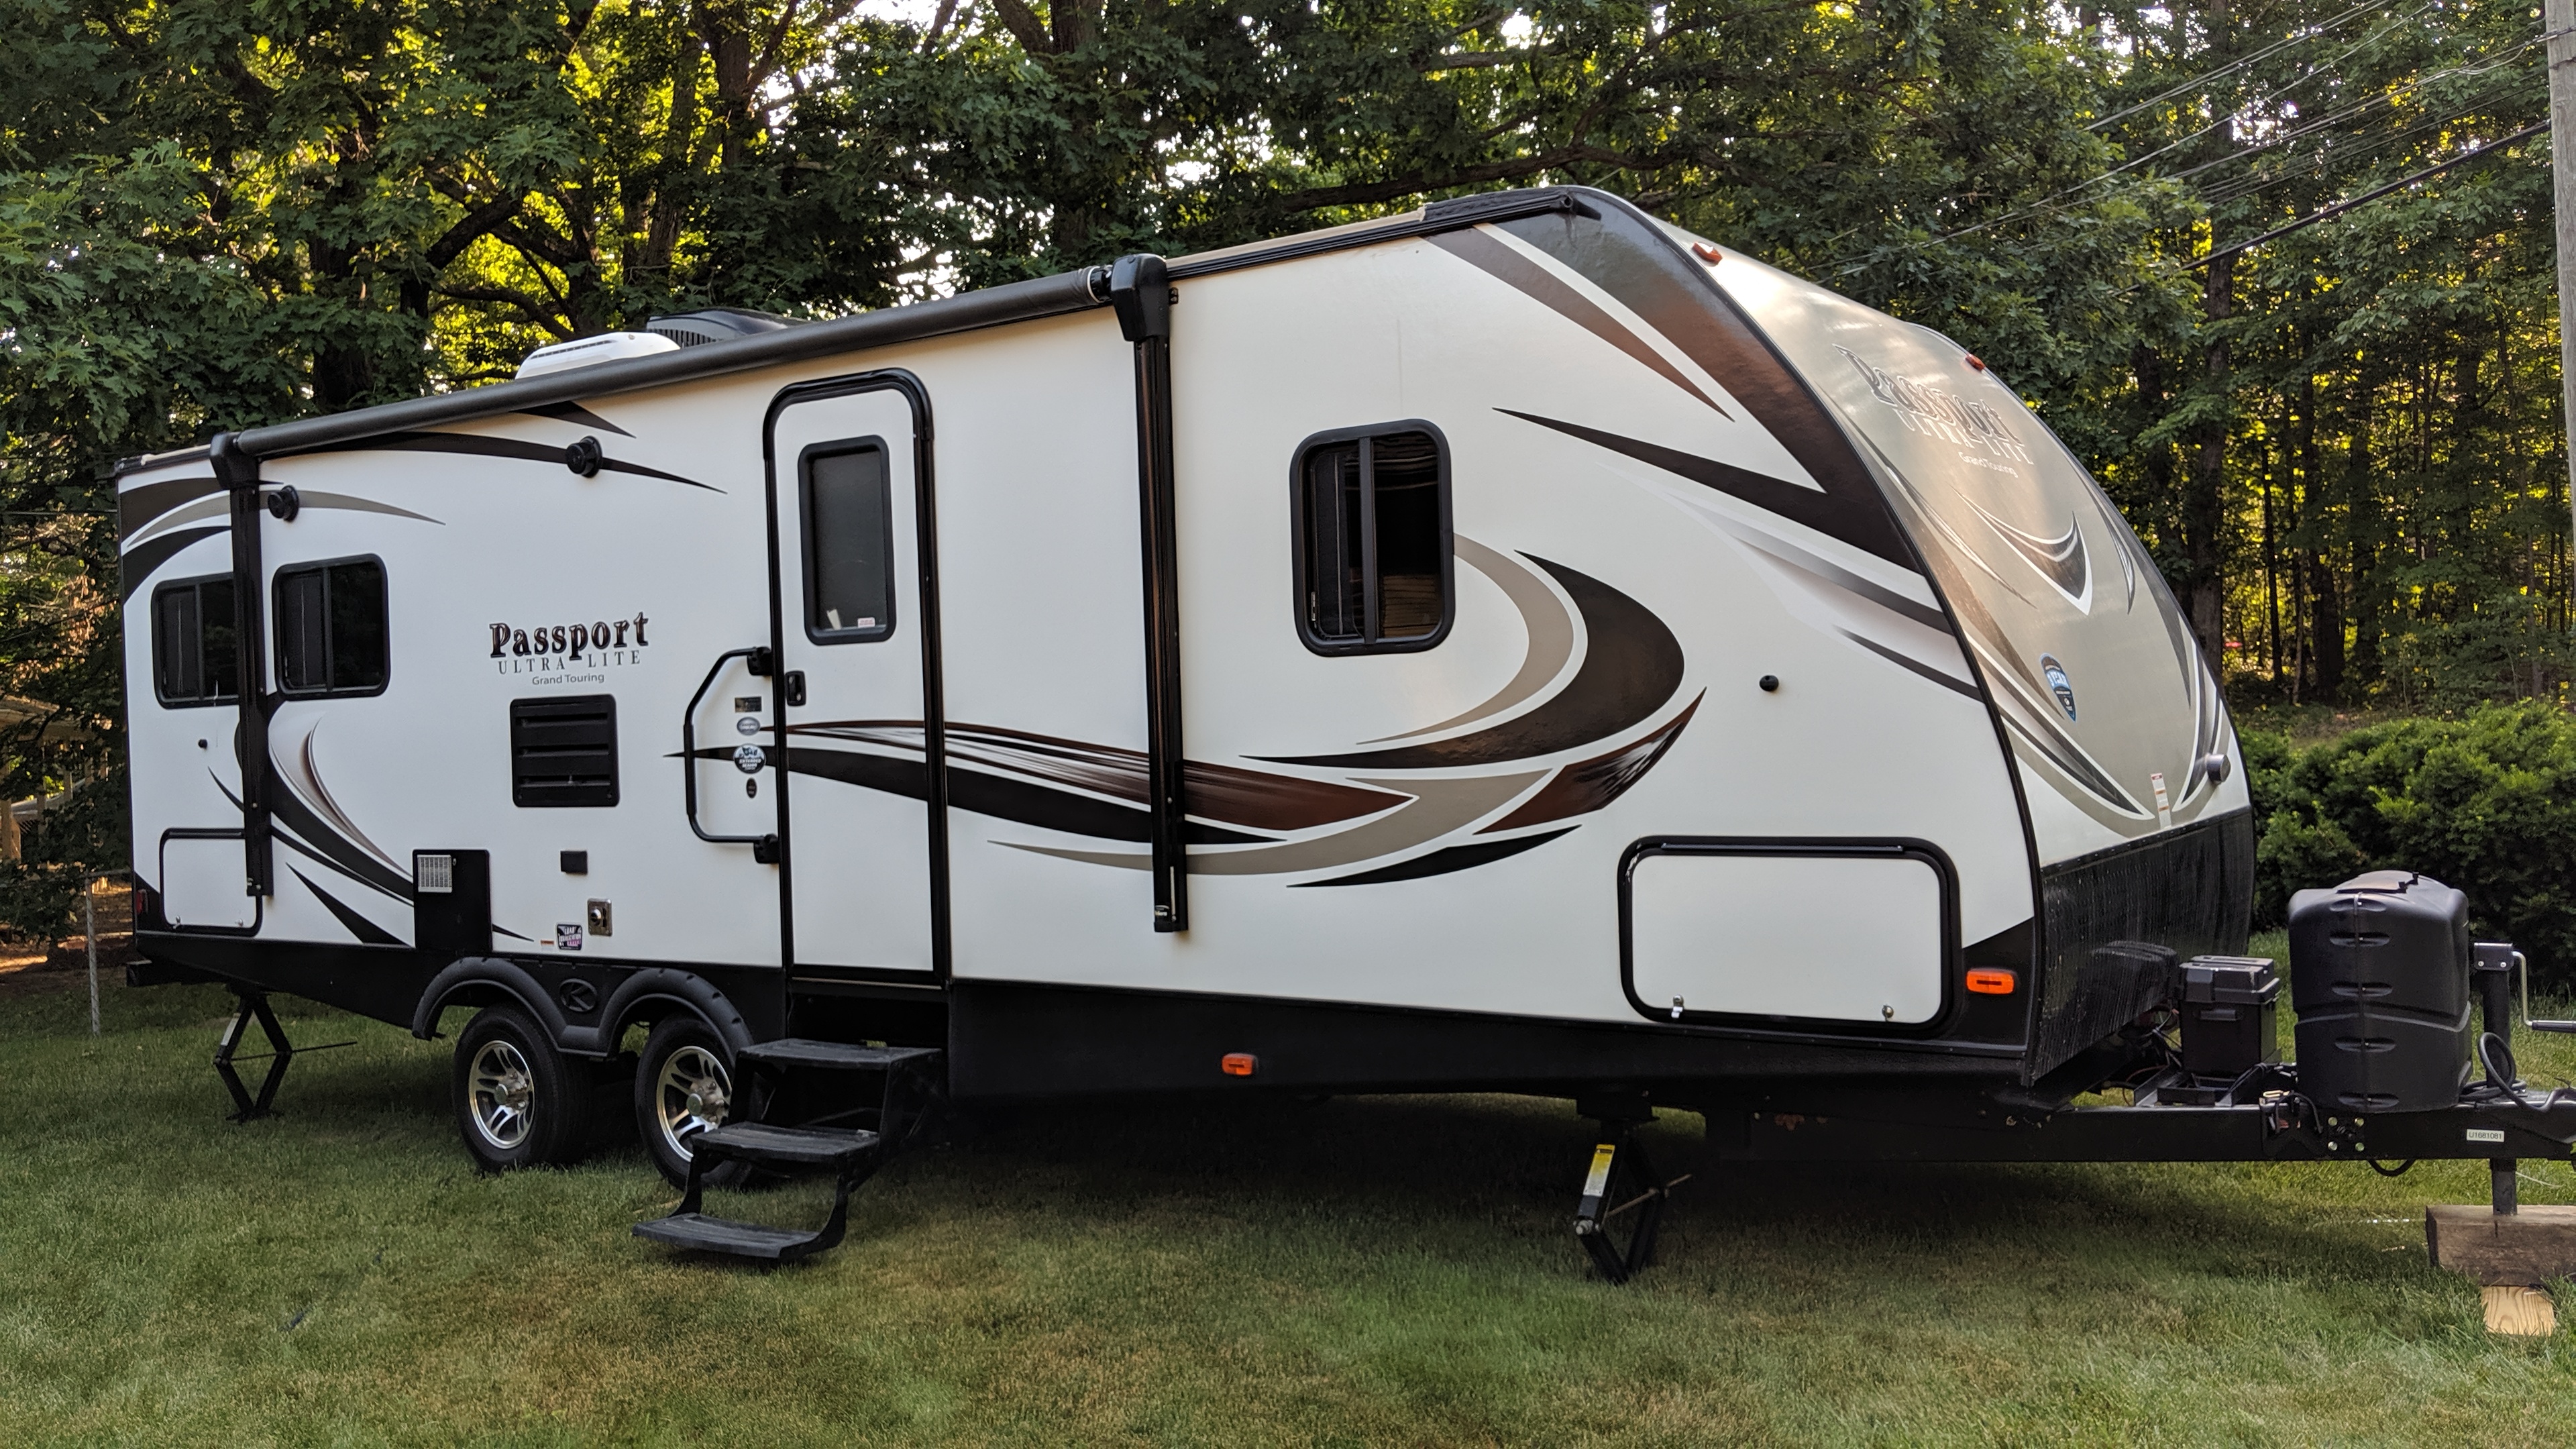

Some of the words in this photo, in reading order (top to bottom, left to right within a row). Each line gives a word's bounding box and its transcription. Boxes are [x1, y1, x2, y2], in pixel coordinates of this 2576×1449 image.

[1892, 408, 1975, 448] ULTRA
[1981, 435, 2034, 465] LITE
[1958, 451, 1986, 468] Grand
[1982, 458, 2019, 478] Touring
[489, 611, 649, 661] Passport
[498, 656, 565, 675] ULTRA
[588, 649, 641, 668] LITE
[532, 674, 563, 685] Grand
[564, 673, 604, 683] Touring
